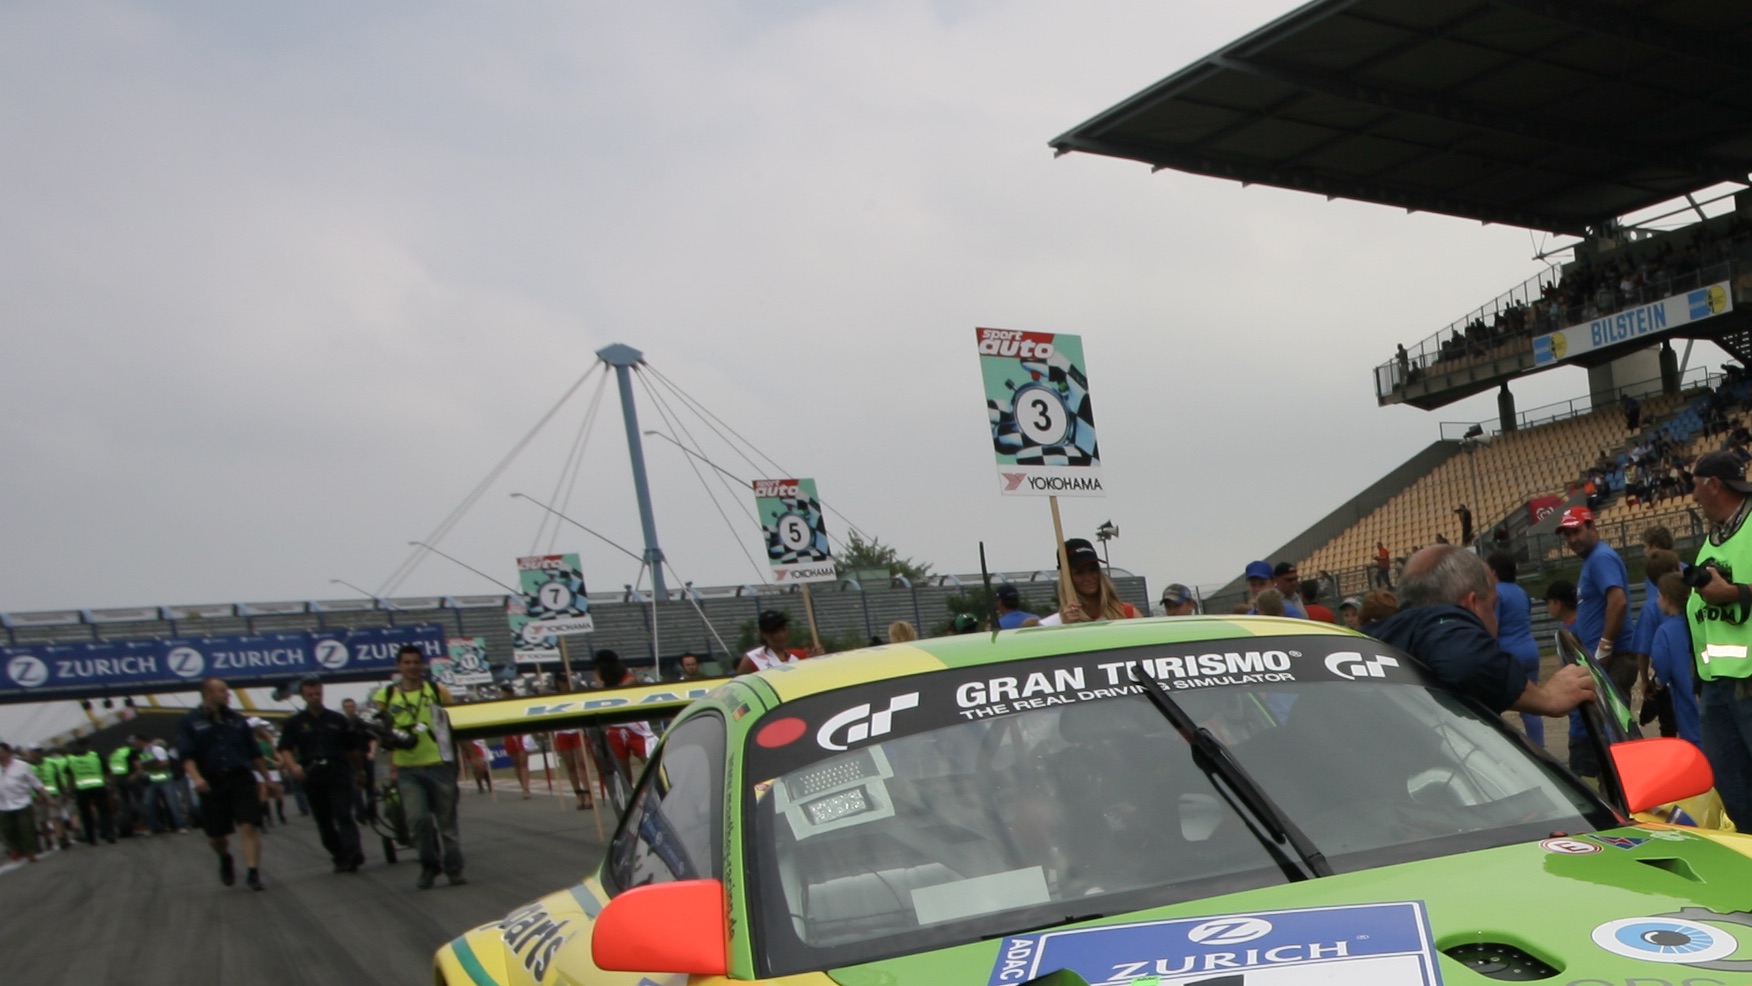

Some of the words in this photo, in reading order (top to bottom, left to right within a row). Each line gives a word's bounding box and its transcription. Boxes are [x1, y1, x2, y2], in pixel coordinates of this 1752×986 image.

[981, 328, 1023, 341] sport
[1590, 302, 1667, 347] BILSTEIN
[979, 338, 1055, 359] auto
[1030, 399, 1053, 431] 3
[755, 486, 799, 497] auto
[1027, 476, 1104, 491] YOKOHAMA
[788, 522, 802, 543] 5
[791, 567, 835, 579] YOKOHAMA
[549, 588, 561, 605] 7
[545, 622, 592, 632] YOKOHAMA
[56, 656, 158, 678] ZURICH
[213, 648, 305, 669] ZURICH
[956, 664, 1087, 708] GRAN
[1098, 650, 1291, 686] TURISMO
[960, 701, 1010, 720] THE
[1014, 693, 1076, 713] REAL
[1174, 671, 1296, 690] SIMULATOR
[1000, 939, 1034, 980] ADAC
[1107, 941, 1349, 981] ZURICH
